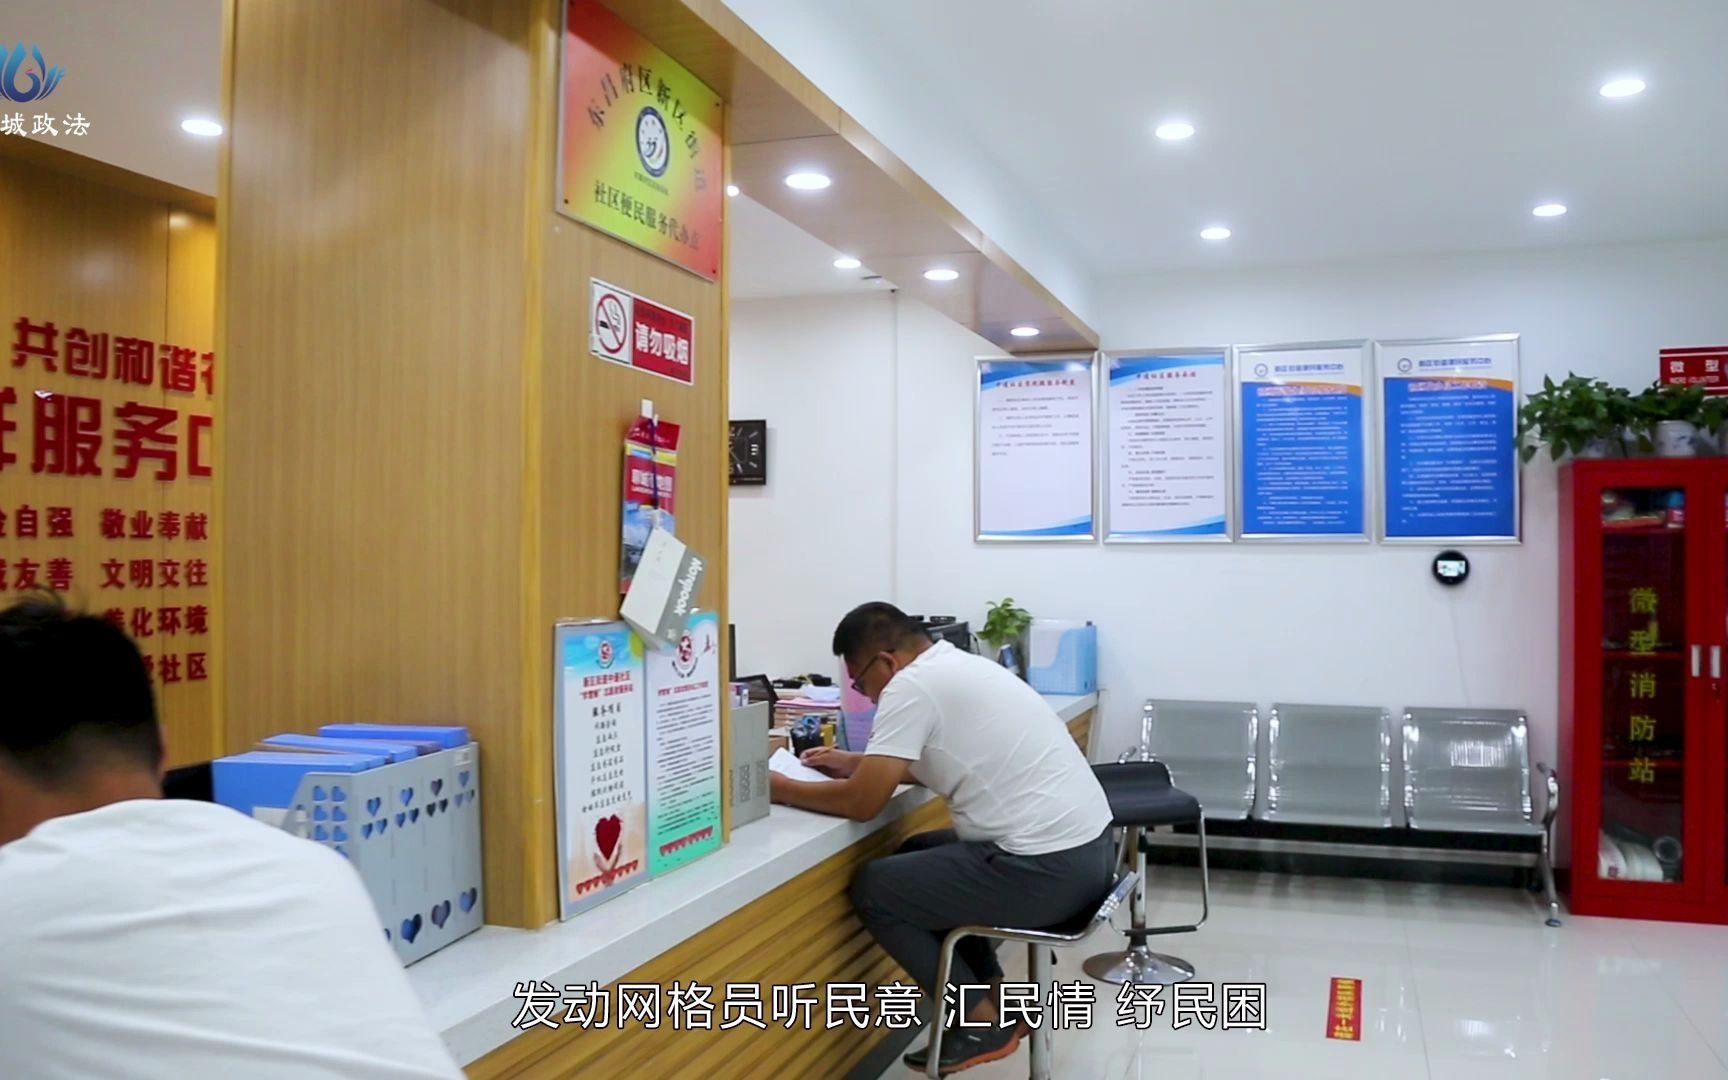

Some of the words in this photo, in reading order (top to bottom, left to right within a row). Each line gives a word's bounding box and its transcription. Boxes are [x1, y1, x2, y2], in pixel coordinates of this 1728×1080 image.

[635, 321, 689, 365] 请勿吸烟
[101, 508, 208, 541] 敬业奉献
[101, 558, 208, 589] 文明交往
[1628, 586, 1658, 784] 微型消防站
